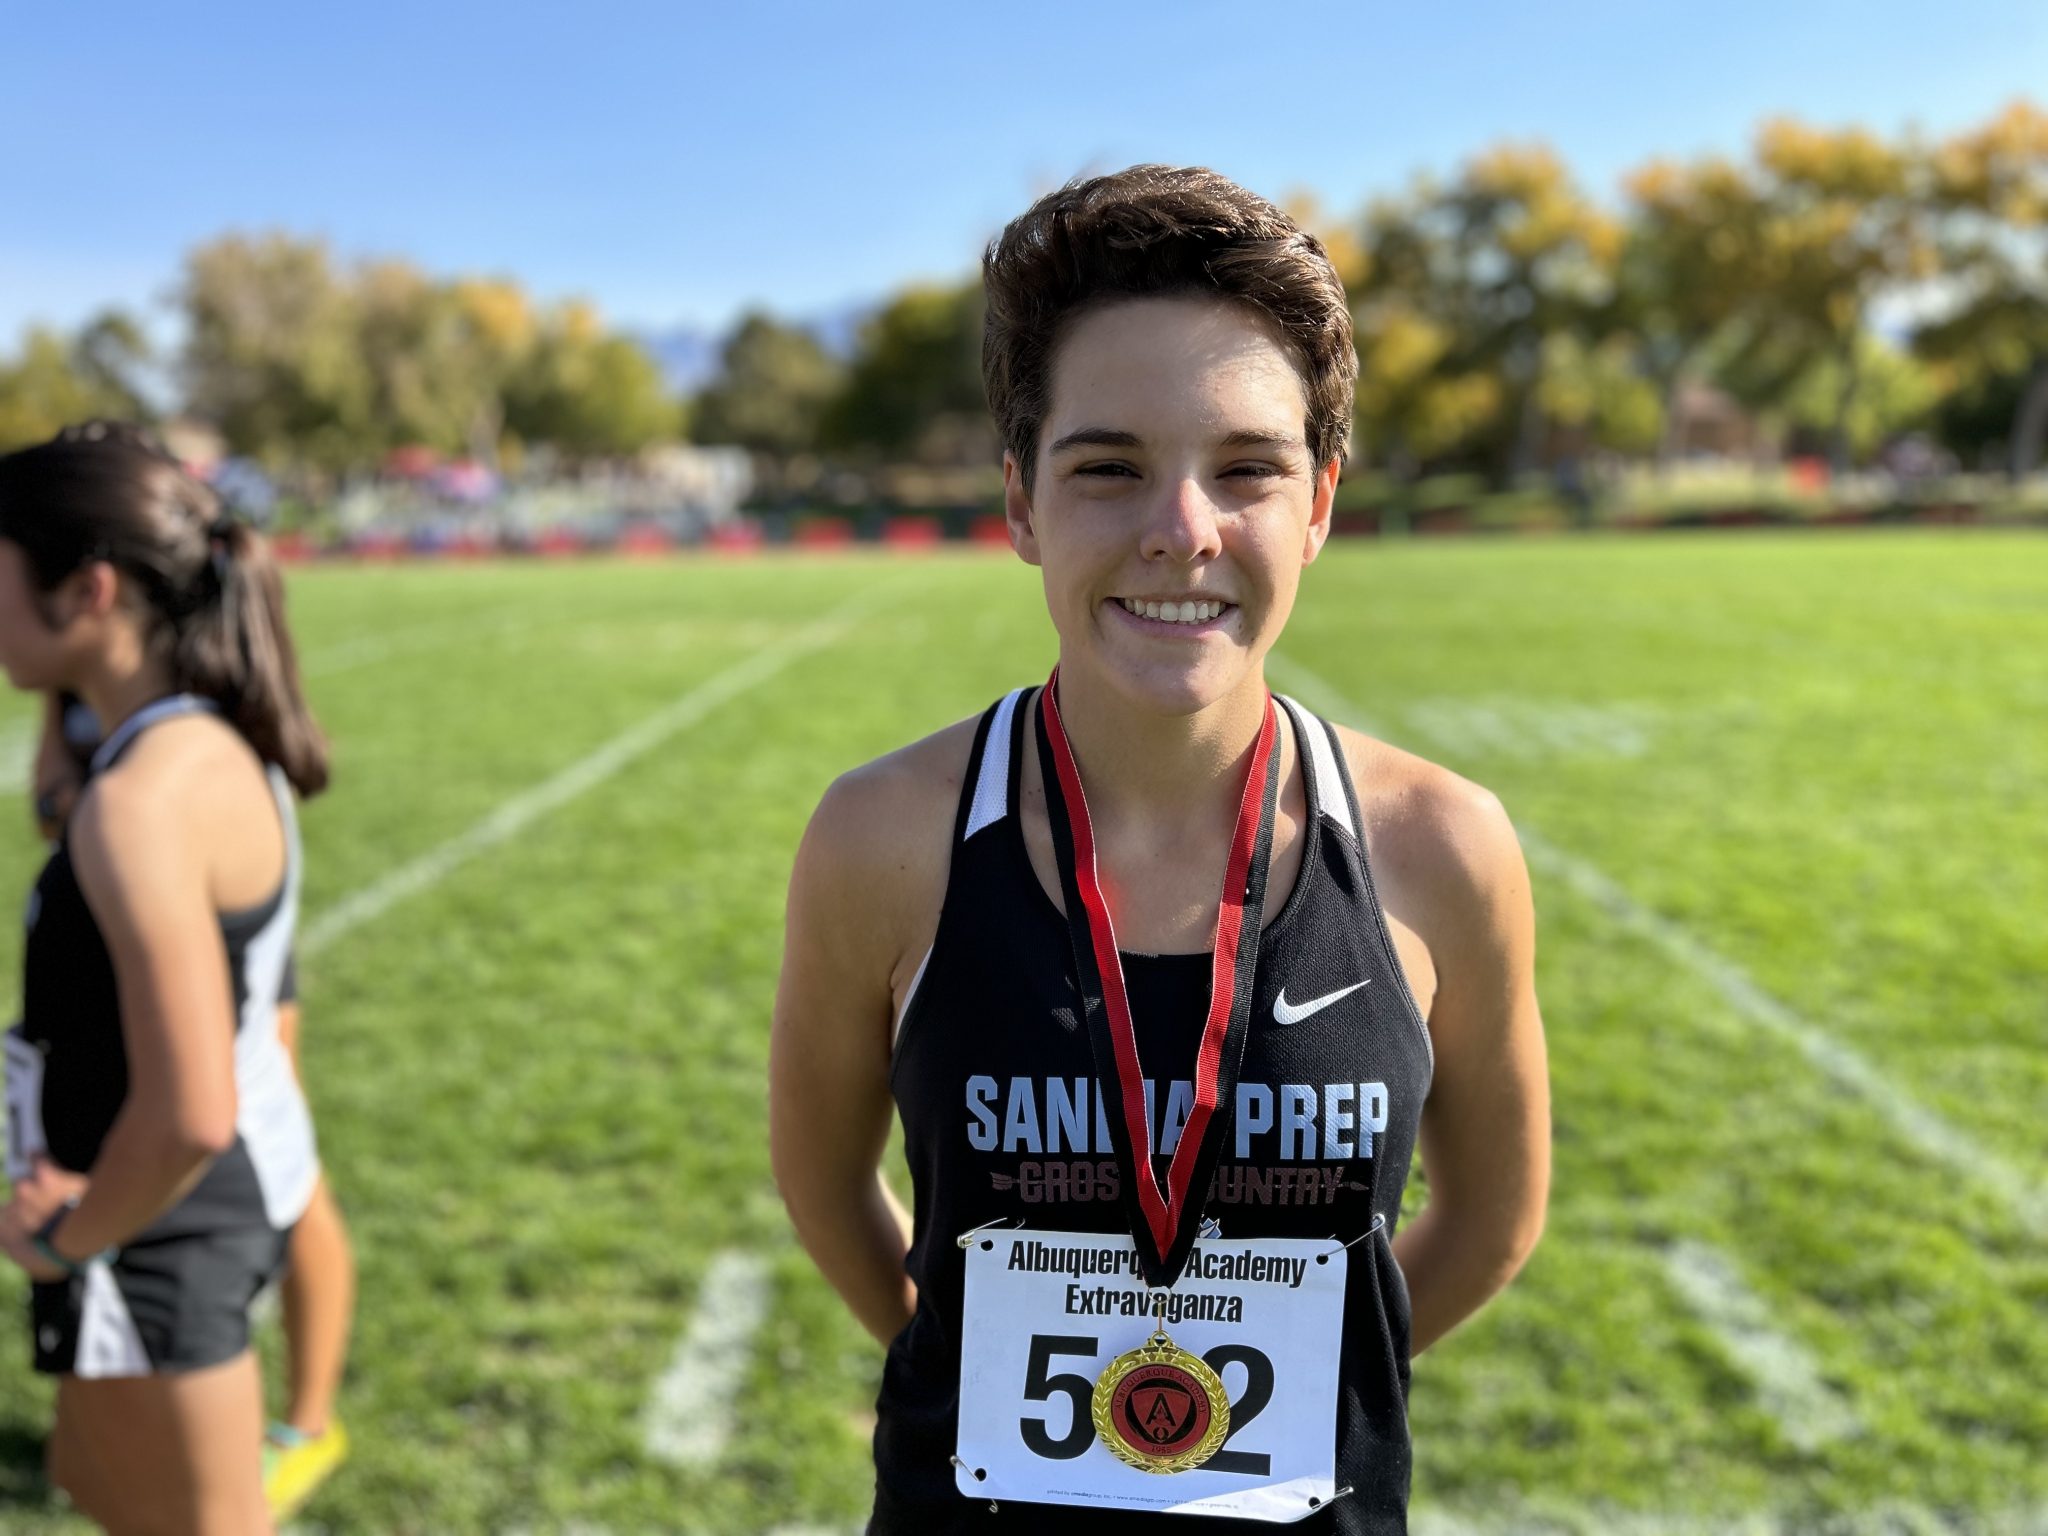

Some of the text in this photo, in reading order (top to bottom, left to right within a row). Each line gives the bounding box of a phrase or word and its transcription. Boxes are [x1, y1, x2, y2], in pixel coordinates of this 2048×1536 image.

[1235, 1082, 1388, 1160] PREP
[1019, 1161, 1120, 1203] CROS
[1007, 1240, 1307, 1289] Albuquerq Academy
[1065, 1283, 1243, 1324] Extravaganza
[1019, 1333, 1275, 1477] 52
